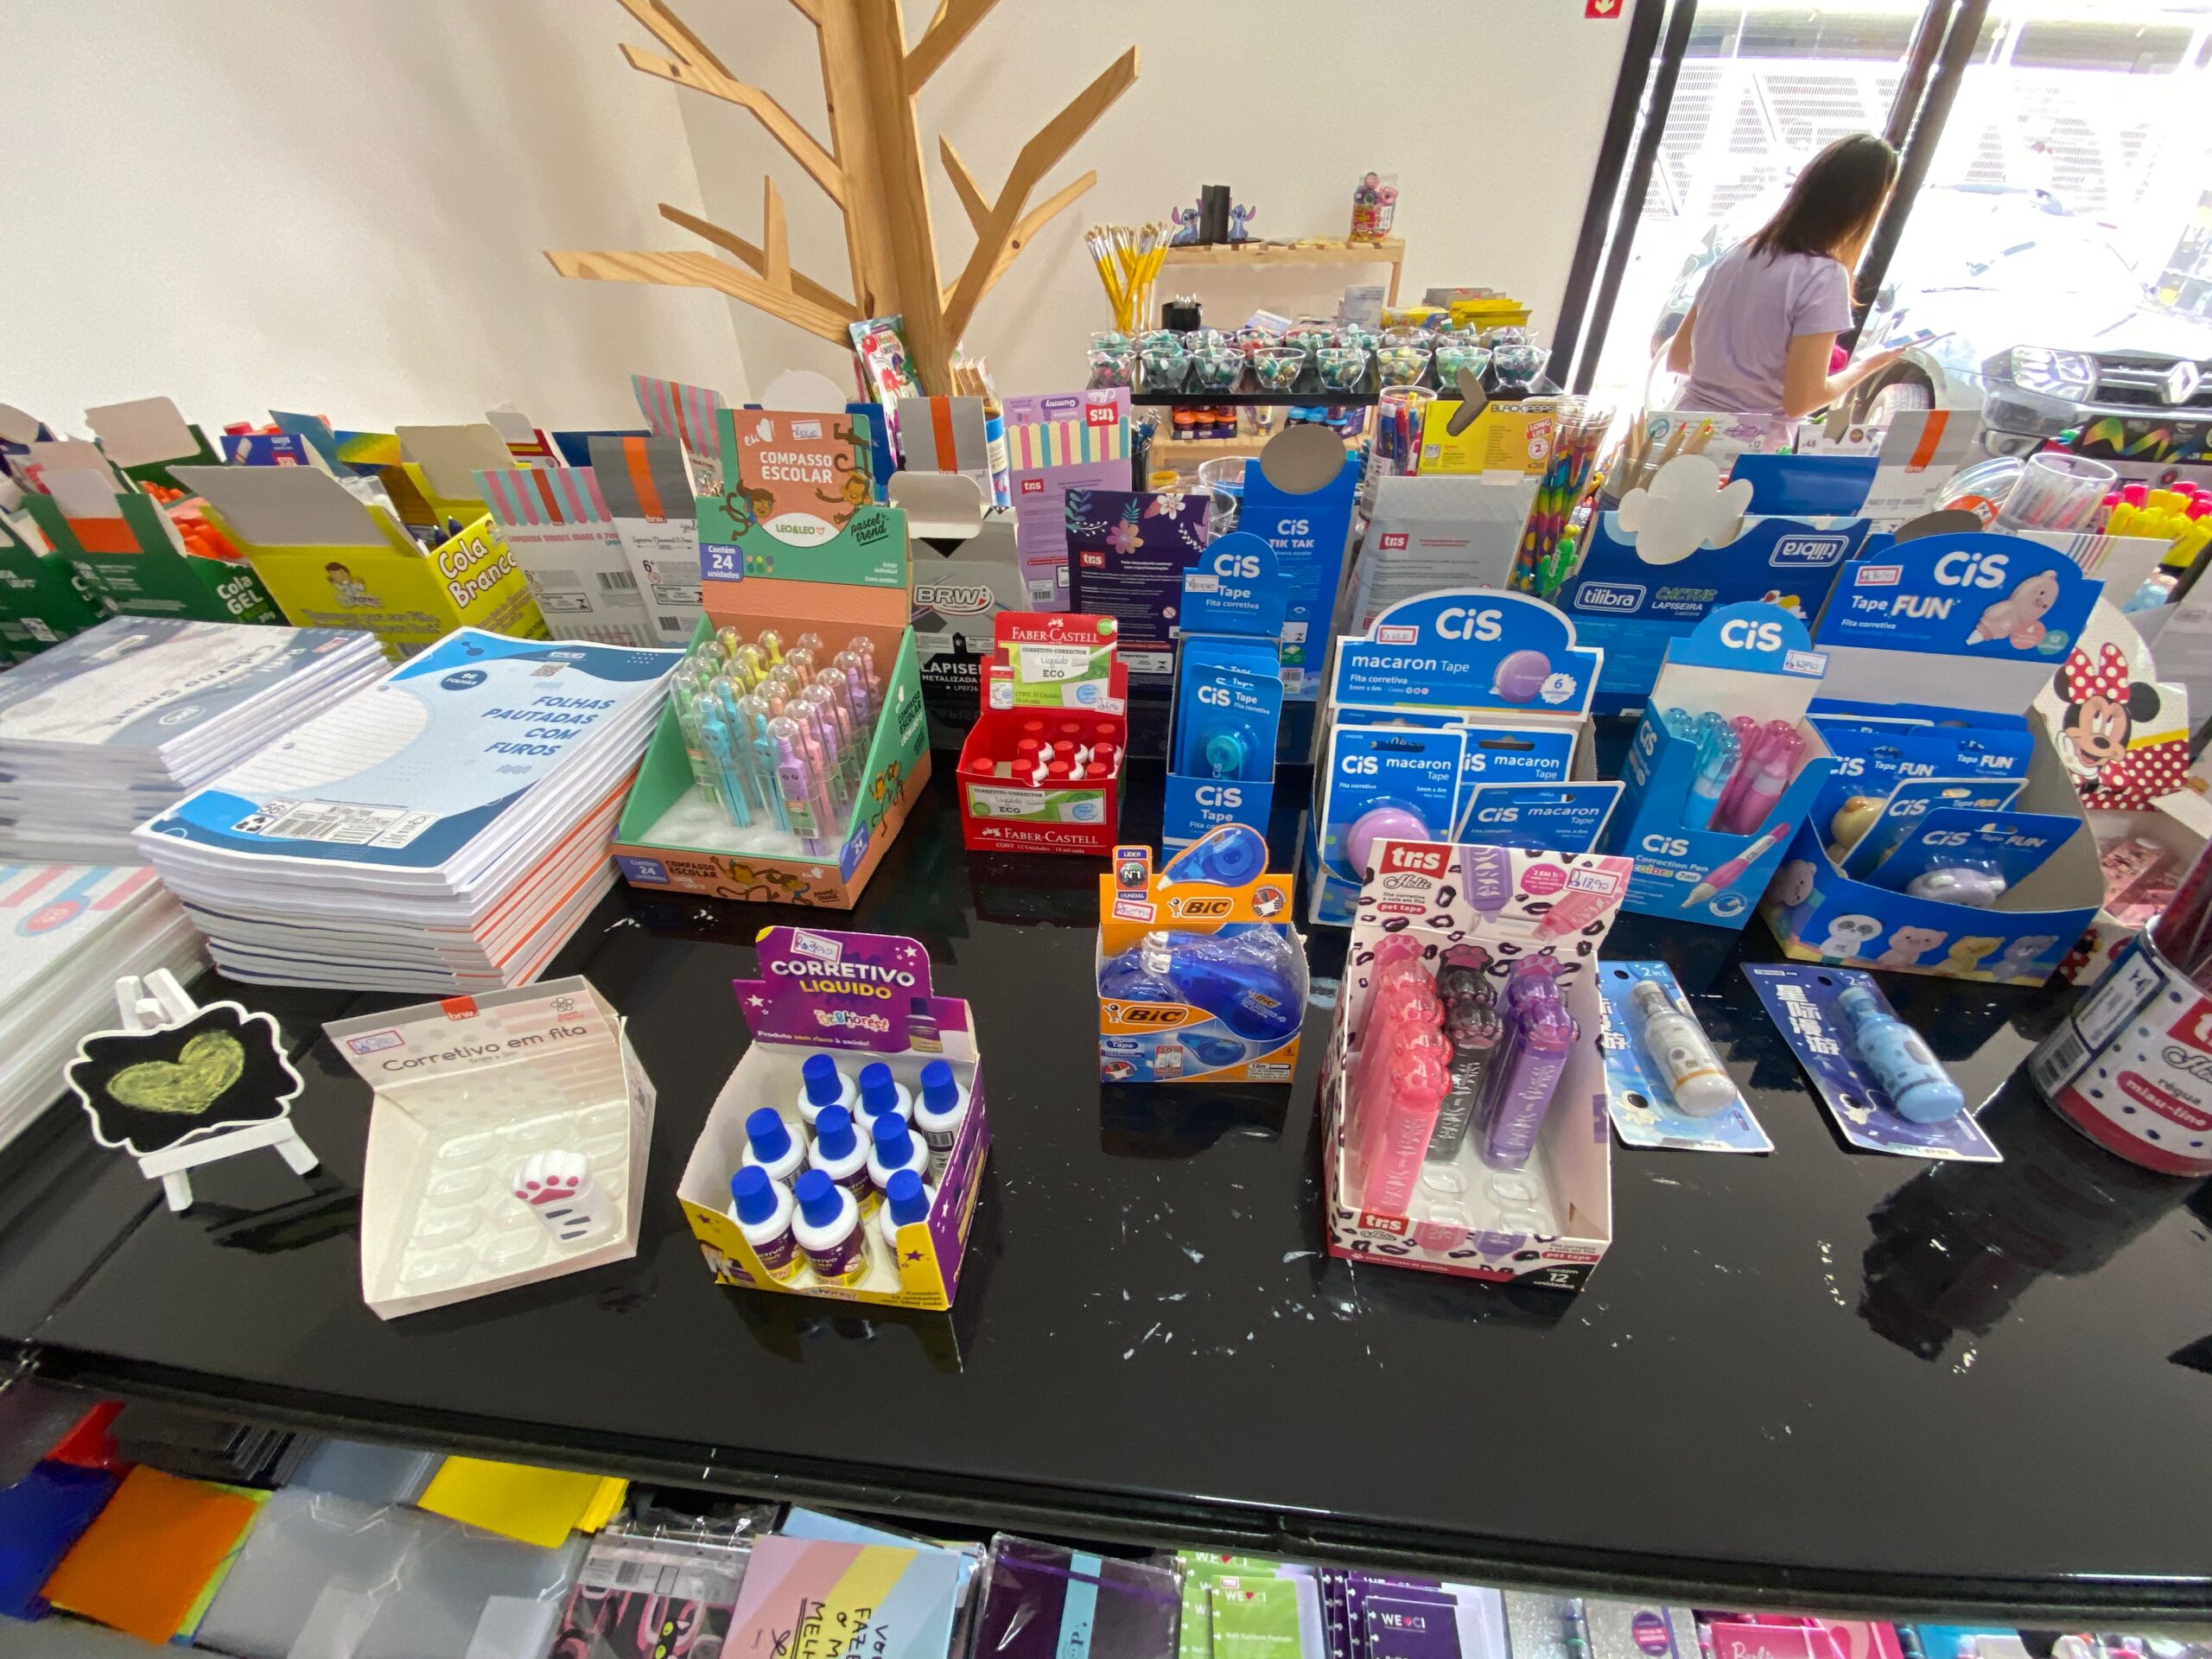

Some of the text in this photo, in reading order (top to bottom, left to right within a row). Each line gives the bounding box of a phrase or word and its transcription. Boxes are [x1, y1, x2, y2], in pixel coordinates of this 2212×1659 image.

[1045, 399, 1076, 408] Gummy
[1089, 408, 1115, 423] tris
[1529, 419, 1551, 430] LONG
[1532, 429, 1546, 437] LIFE
[1535, 444, 1542, 453] 2
[760, 451, 833, 467] COMPASSO
[761, 466, 833, 485] ESCOLAR
[1023, 481, 1042, 491] tris
[776, 524, 815, 535] LEO&LEO
[850, 513, 881, 536] pastel
[1277, 518, 1309, 536] CiS
[855, 523, 887, 543] trend
[1269, 538, 1314, 549] TIK TAK
[1384, 535, 1405, 548] tris
[708, 545, 735, 555] Contém
[1782, 541, 1838, 561] tilibra
[437, 534, 489, 581] Cola
[712, 554, 733, 569] 24
[1083, 553, 1103, 565] tris
[1213, 554, 1260, 579] CiS
[1934, 551, 2010, 588] CiS
[707, 569, 740, 580] unidades
[216, 575, 254, 601] Cola
[1218, 585, 1250, 601] Tape
[1656, 587, 1718, 602] CACTUS
[226, 589, 264, 616] GEL
[916, 587, 982, 605] BRW
[1584, 588, 1635, 607] tilibra
[1205, 599, 1260, 610] Fita corretiva
[1651, 601, 1703, 611] LAPISEIRA
[1851, 594, 1954, 621] Tape FUN
[1436, 607, 1503, 642] CiS
[1840, 619, 1897, 631] Fita corretiva
[1012, 626, 1099, 644] FABER-CASTELL
[1719, 619, 1783, 652] CiS
[1351, 655, 1470, 674] macaron Tape
[445, 677, 478, 685] FOLHAS
[922, 675, 978, 683] METALIZADA
[1042, 670, 1065, 678] ECO
[1350, 673, 1408, 685] Fita corretiva
[1349, 683, 1366, 692] 5mm
[1554, 677, 1563, 689] 6
[531, 696, 616, 710] FOLHAS
[1198, 685, 1231, 707] CiS
[1235, 691, 1258, 704] Tape
[480, 708, 599, 725] PAUTADAS
[1244, 704, 1270, 715] corretiva
[524, 728, 582, 741] COM
[484, 741, 562, 757] FUROS
[1342, 754, 1379, 775] CiS
[1386, 758, 1452, 771] macaron
[1462, 753, 1486, 772] iS
[1494, 755, 1560, 769] macaron
[1957, 753, 2015, 769] Tape FUN
[1535, 769, 1558, 780] Tape
[1873, 760, 1936, 778] Tape FUN
[1427, 771, 1450, 782] Tape
[1195, 785, 1243, 808] CiS
[1528, 807, 1599, 817] macaron
[1889, 798, 1929, 817] CiS
[1200, 809, 1234, 823] Tape
[1478, 807, 1520, 823] CiS
[1571, 817, 1595, 826] Tape
[1004, 828, 1098, 844] FABER-CASTELL
[1923, 830, 1973, 846] CiS
[2005, 836, 2048, 849] FUN
[1642, 834, 1690, 856] CiS
[1391, 847, 1441, 870] tris
[1636, 854, 1709, 873] Correction Pen
[639, 866, 656, 875] 24
[665, 859, 715, 873] COMPASSO
[669, 867, 718, 880] ESCOLAR
[1679, 872, 1699, 881] 7ml
[1381, 903, 1422, 913] pet tape
[771, 960, 916, 987] CORRETIVO
[1641, 966, 1669, 977] 2in1
[798, 979, 892, 1000] LIQUIDO
[447, 1007, 476, 1020] brw
[757, 1030, 792, 1039] Produto
[382, 1041, 500, 1073] Corretivo
[506, 1034, 543, 1050] em
[549, 1025, 588, 1039] fita
[2158, 1077, 2202, 1105] régua
[2125, 1078, 2208, 1128] miau-line
[1365, 1214, 1402, 1231] tris
[1567, 1253, 1592, 1262] tape
[1546, 1267, 1579, 1275] contém
[1549, 1273, 1567, 1283] 12
[1533, 1280, 1574, 1290] unidades
[1225, 1591, 1245, 1601] WE
[1381, 1612, 1426, 1629] WE CI
